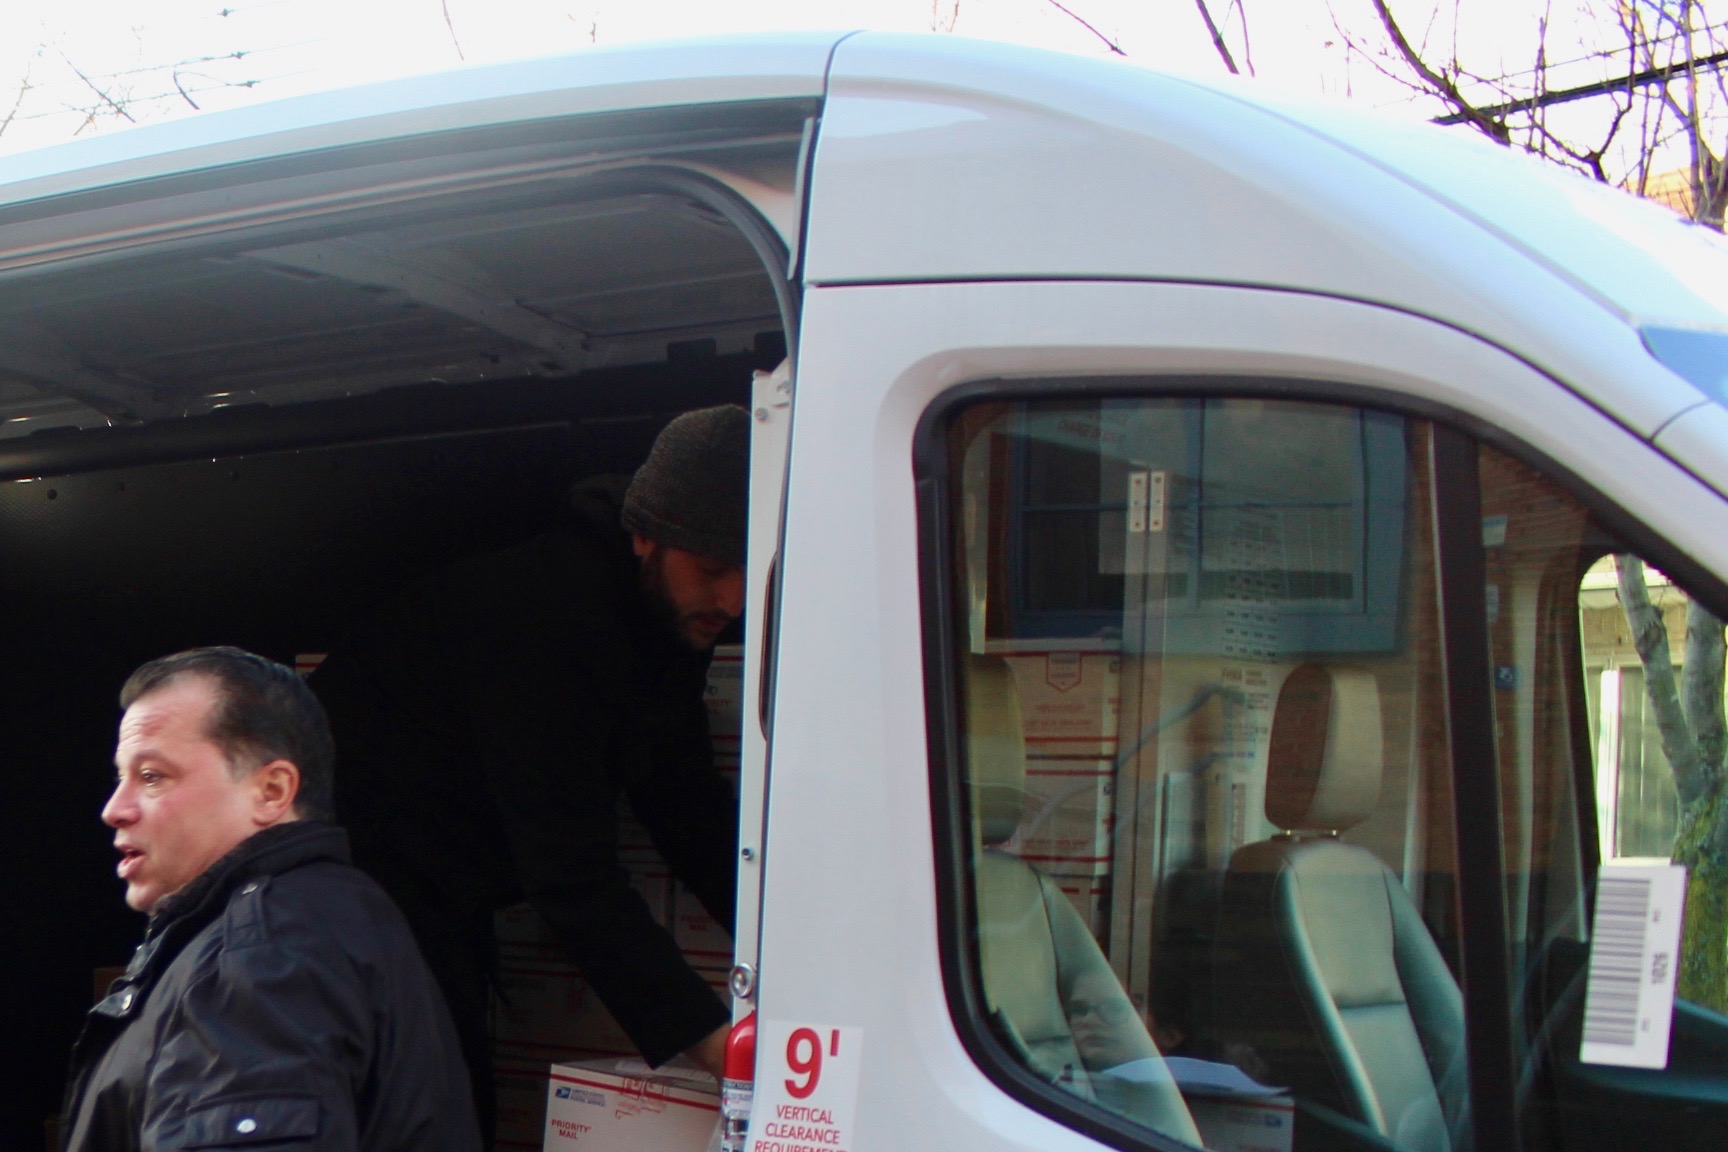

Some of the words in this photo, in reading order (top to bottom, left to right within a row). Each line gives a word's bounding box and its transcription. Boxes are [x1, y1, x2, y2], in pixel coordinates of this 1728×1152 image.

[776, 1105, 834, 1124] VERTICAL
[559, 1129, 579, 1140] MAIL
[765, 1123, 841, 1145] CLEARANCE
